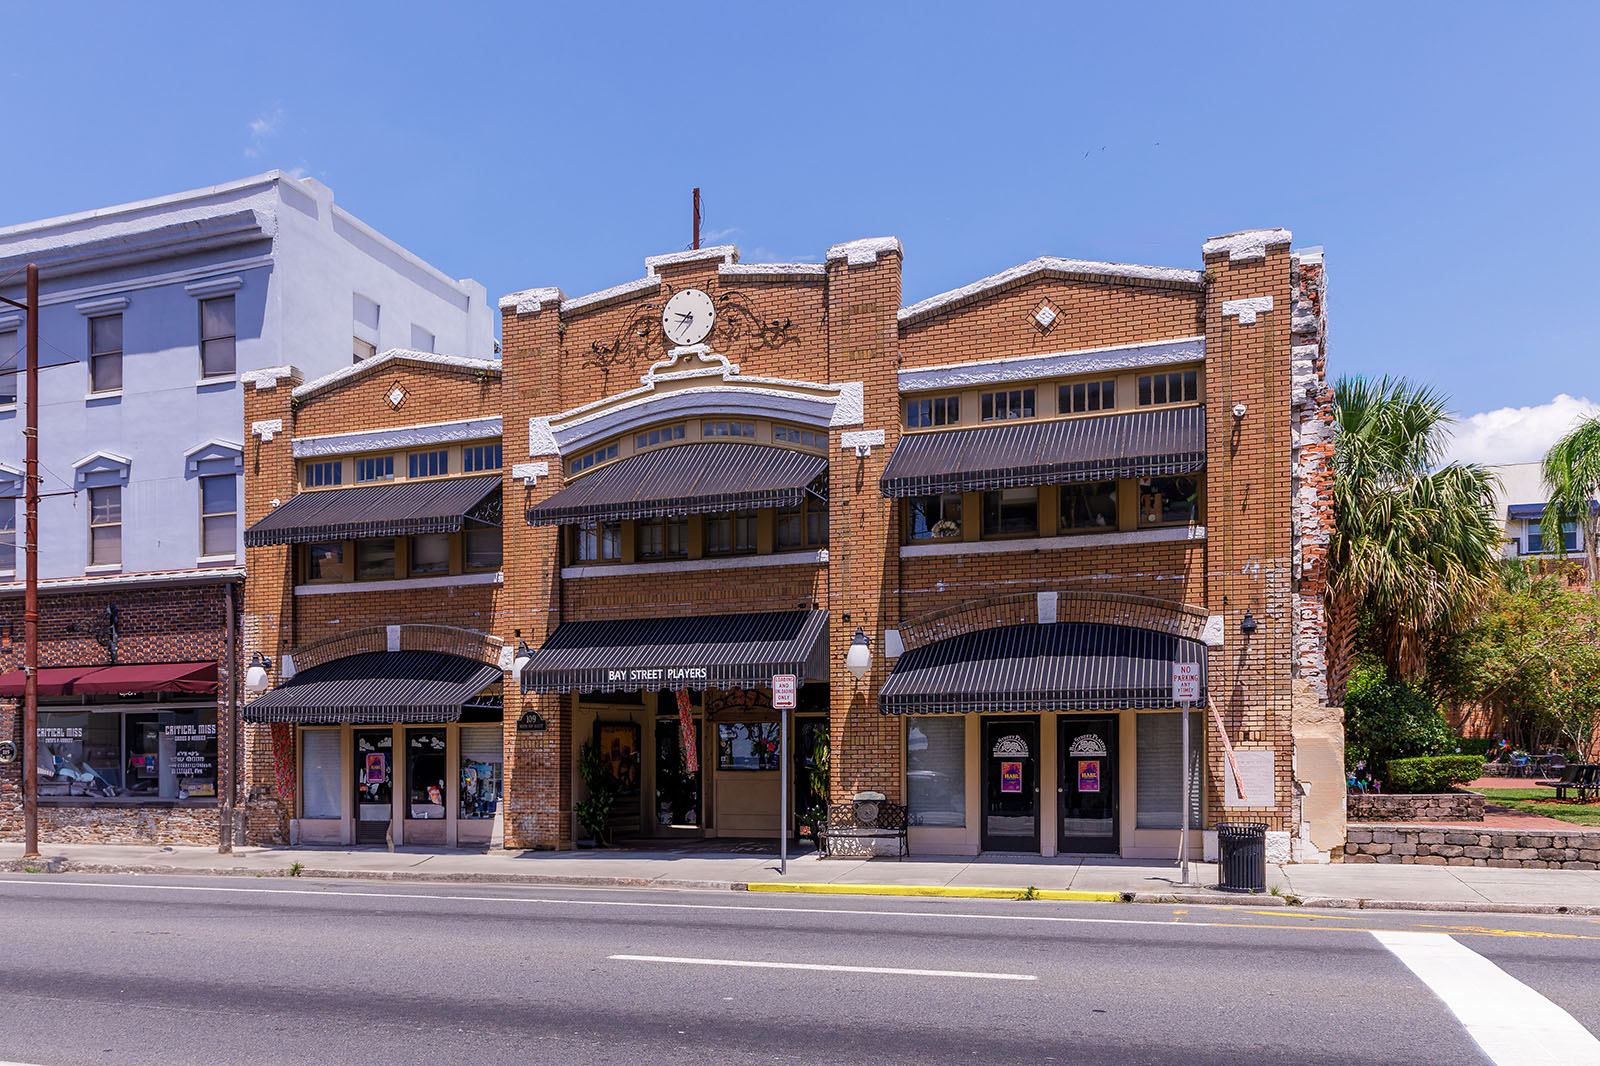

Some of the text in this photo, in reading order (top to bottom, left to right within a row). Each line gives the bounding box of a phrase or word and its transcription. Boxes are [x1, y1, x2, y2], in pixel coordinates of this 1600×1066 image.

[608, 668, 707, 680] BAY STREET PLAYERS
[526, 714, 537, 724] 109
[37, 728, 82, 737] CRITICAL MISS
[165, 725, 196, 735] CRITICAL
[198, 724, 216, 734] MISS
